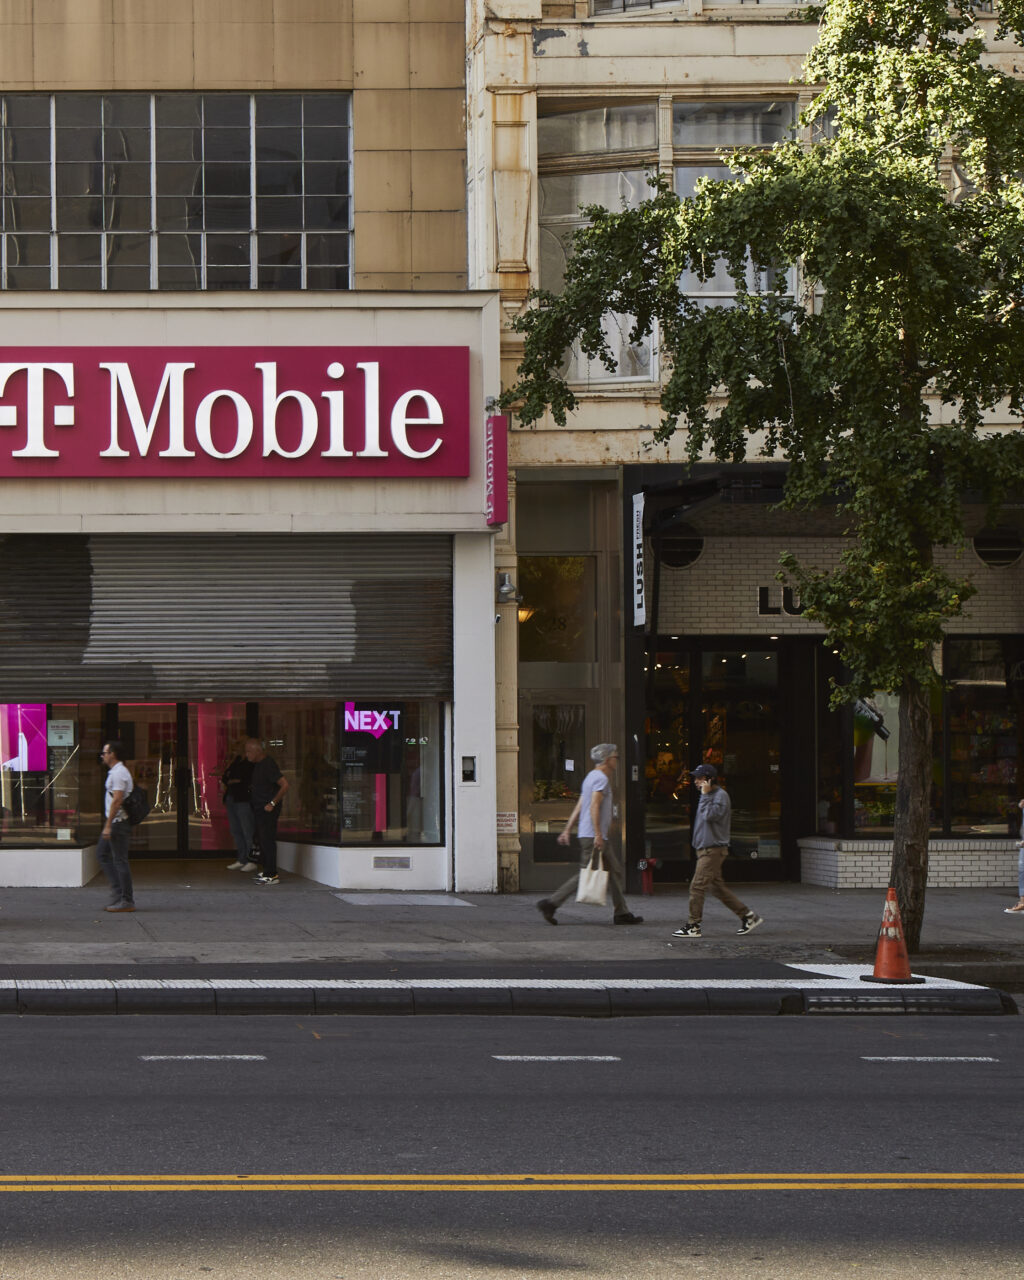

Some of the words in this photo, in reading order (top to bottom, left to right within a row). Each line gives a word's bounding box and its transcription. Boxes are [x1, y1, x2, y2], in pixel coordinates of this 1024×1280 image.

[99, 361, 444, 460] Mobile
[758, 586, 807, 616] LU
[344, 710, 401, 730] NEXT
